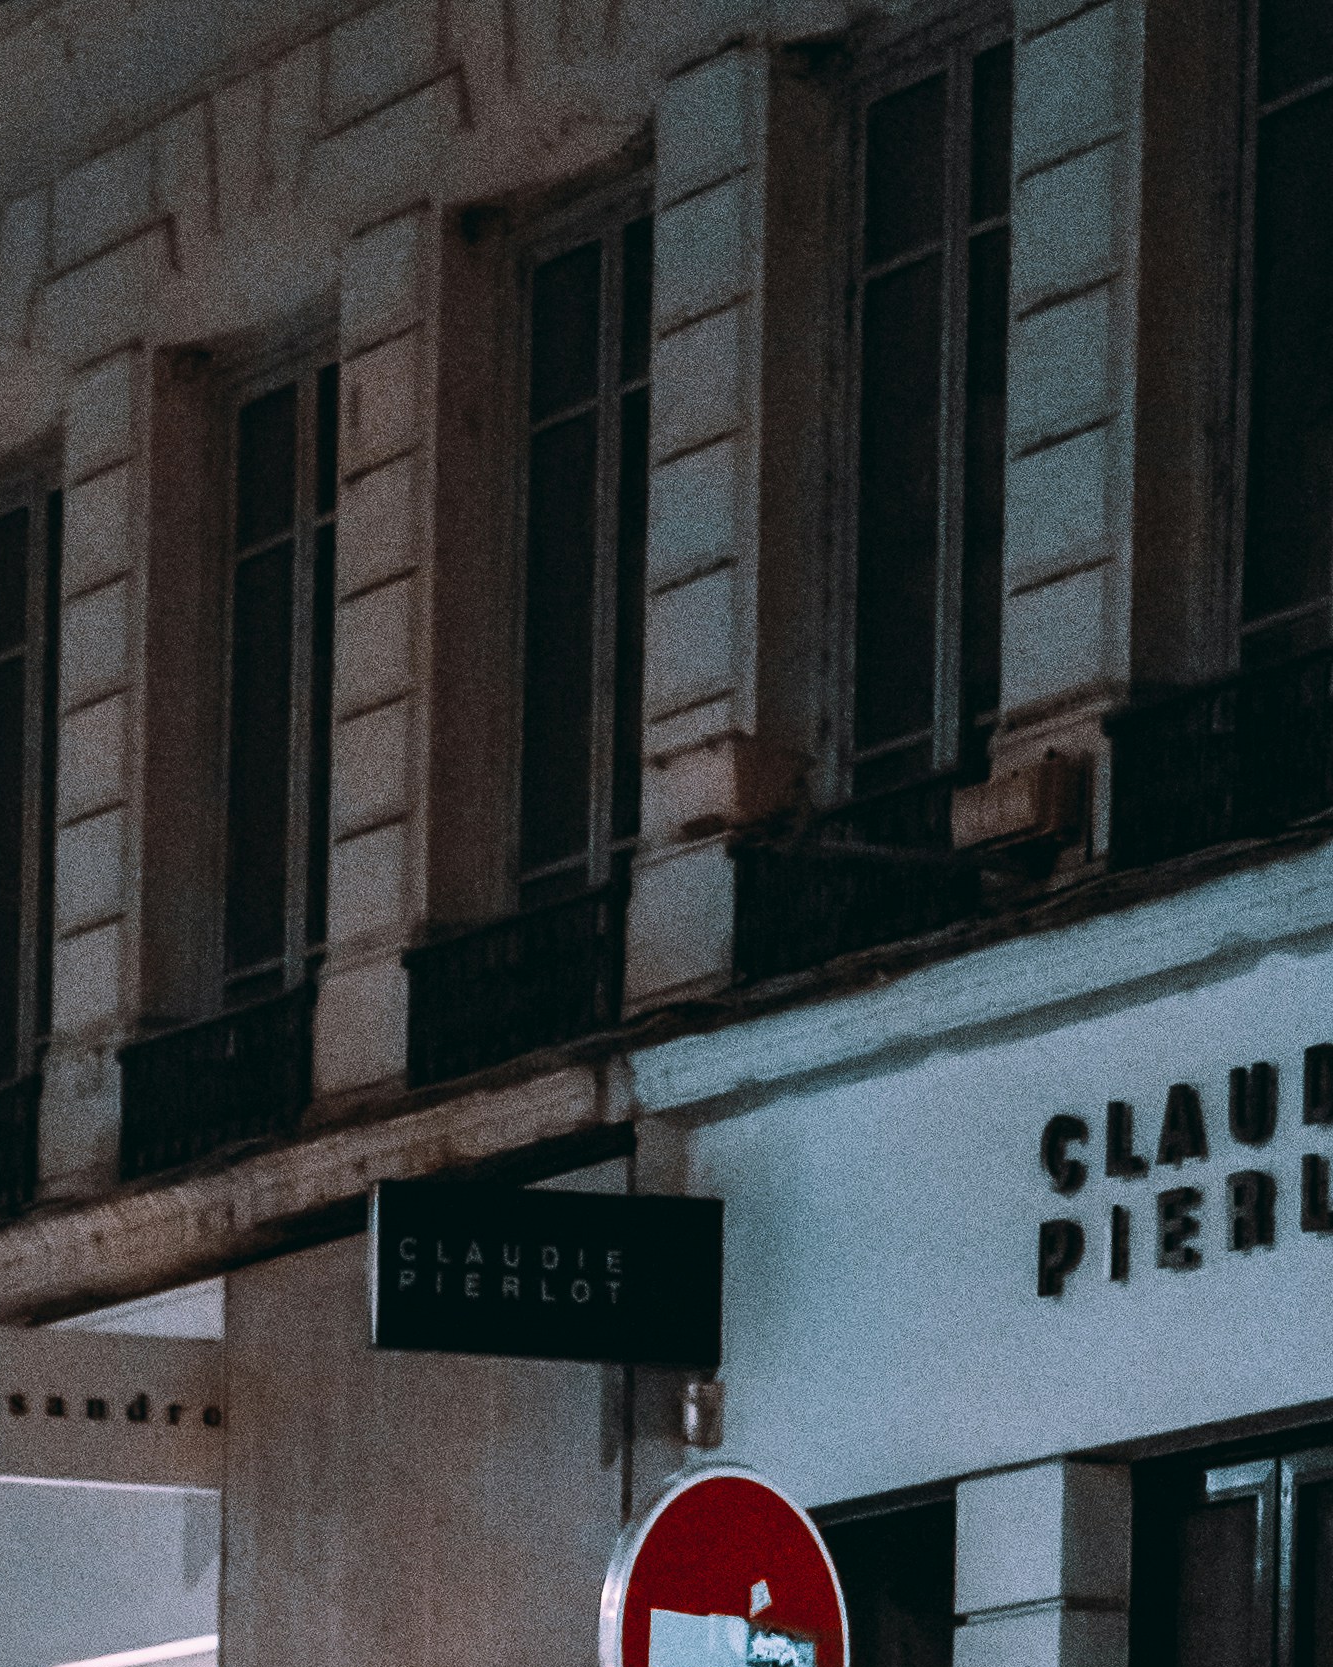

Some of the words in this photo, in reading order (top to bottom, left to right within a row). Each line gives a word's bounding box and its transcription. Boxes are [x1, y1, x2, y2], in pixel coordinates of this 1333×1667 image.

[398, 1236, 623, 1275] CLAUDIE
[398, 1268, 623, 1304] PIERLOT
[8, 1391, 223, 1429] sandro
